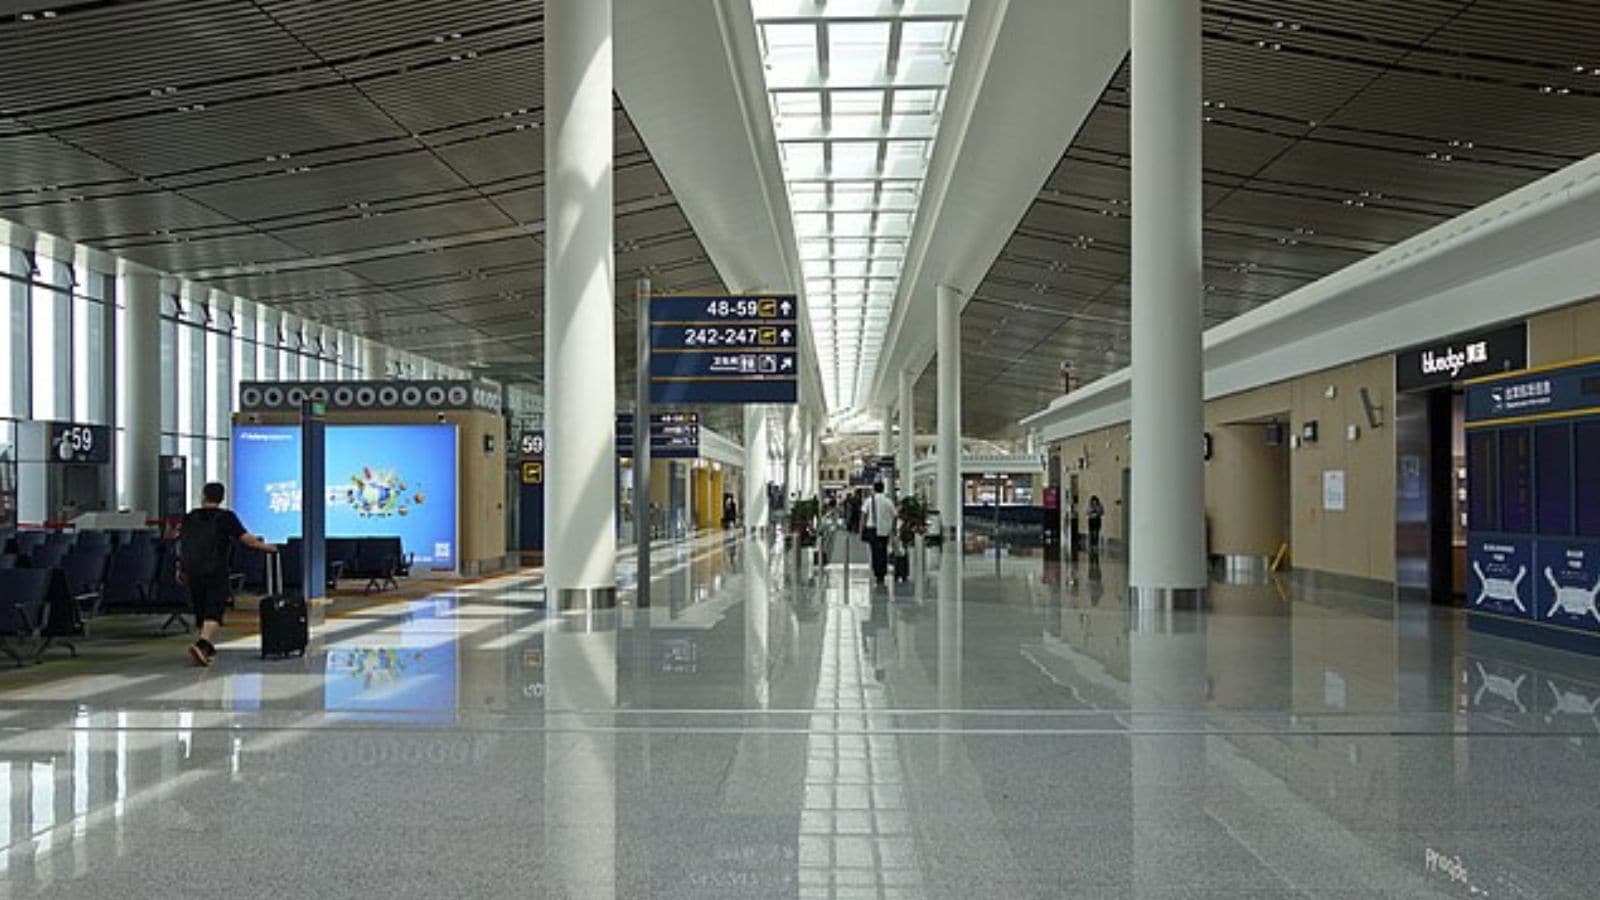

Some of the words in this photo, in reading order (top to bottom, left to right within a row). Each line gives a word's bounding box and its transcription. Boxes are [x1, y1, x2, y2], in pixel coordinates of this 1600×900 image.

[707, 300, 757, 316] 48-59
[685, 328, 757, 345] 242-247
[1422, 347, 1465, 378] bluedge
[72, 427, 92, 451] 59
[522, 434, 543, 454] 59
